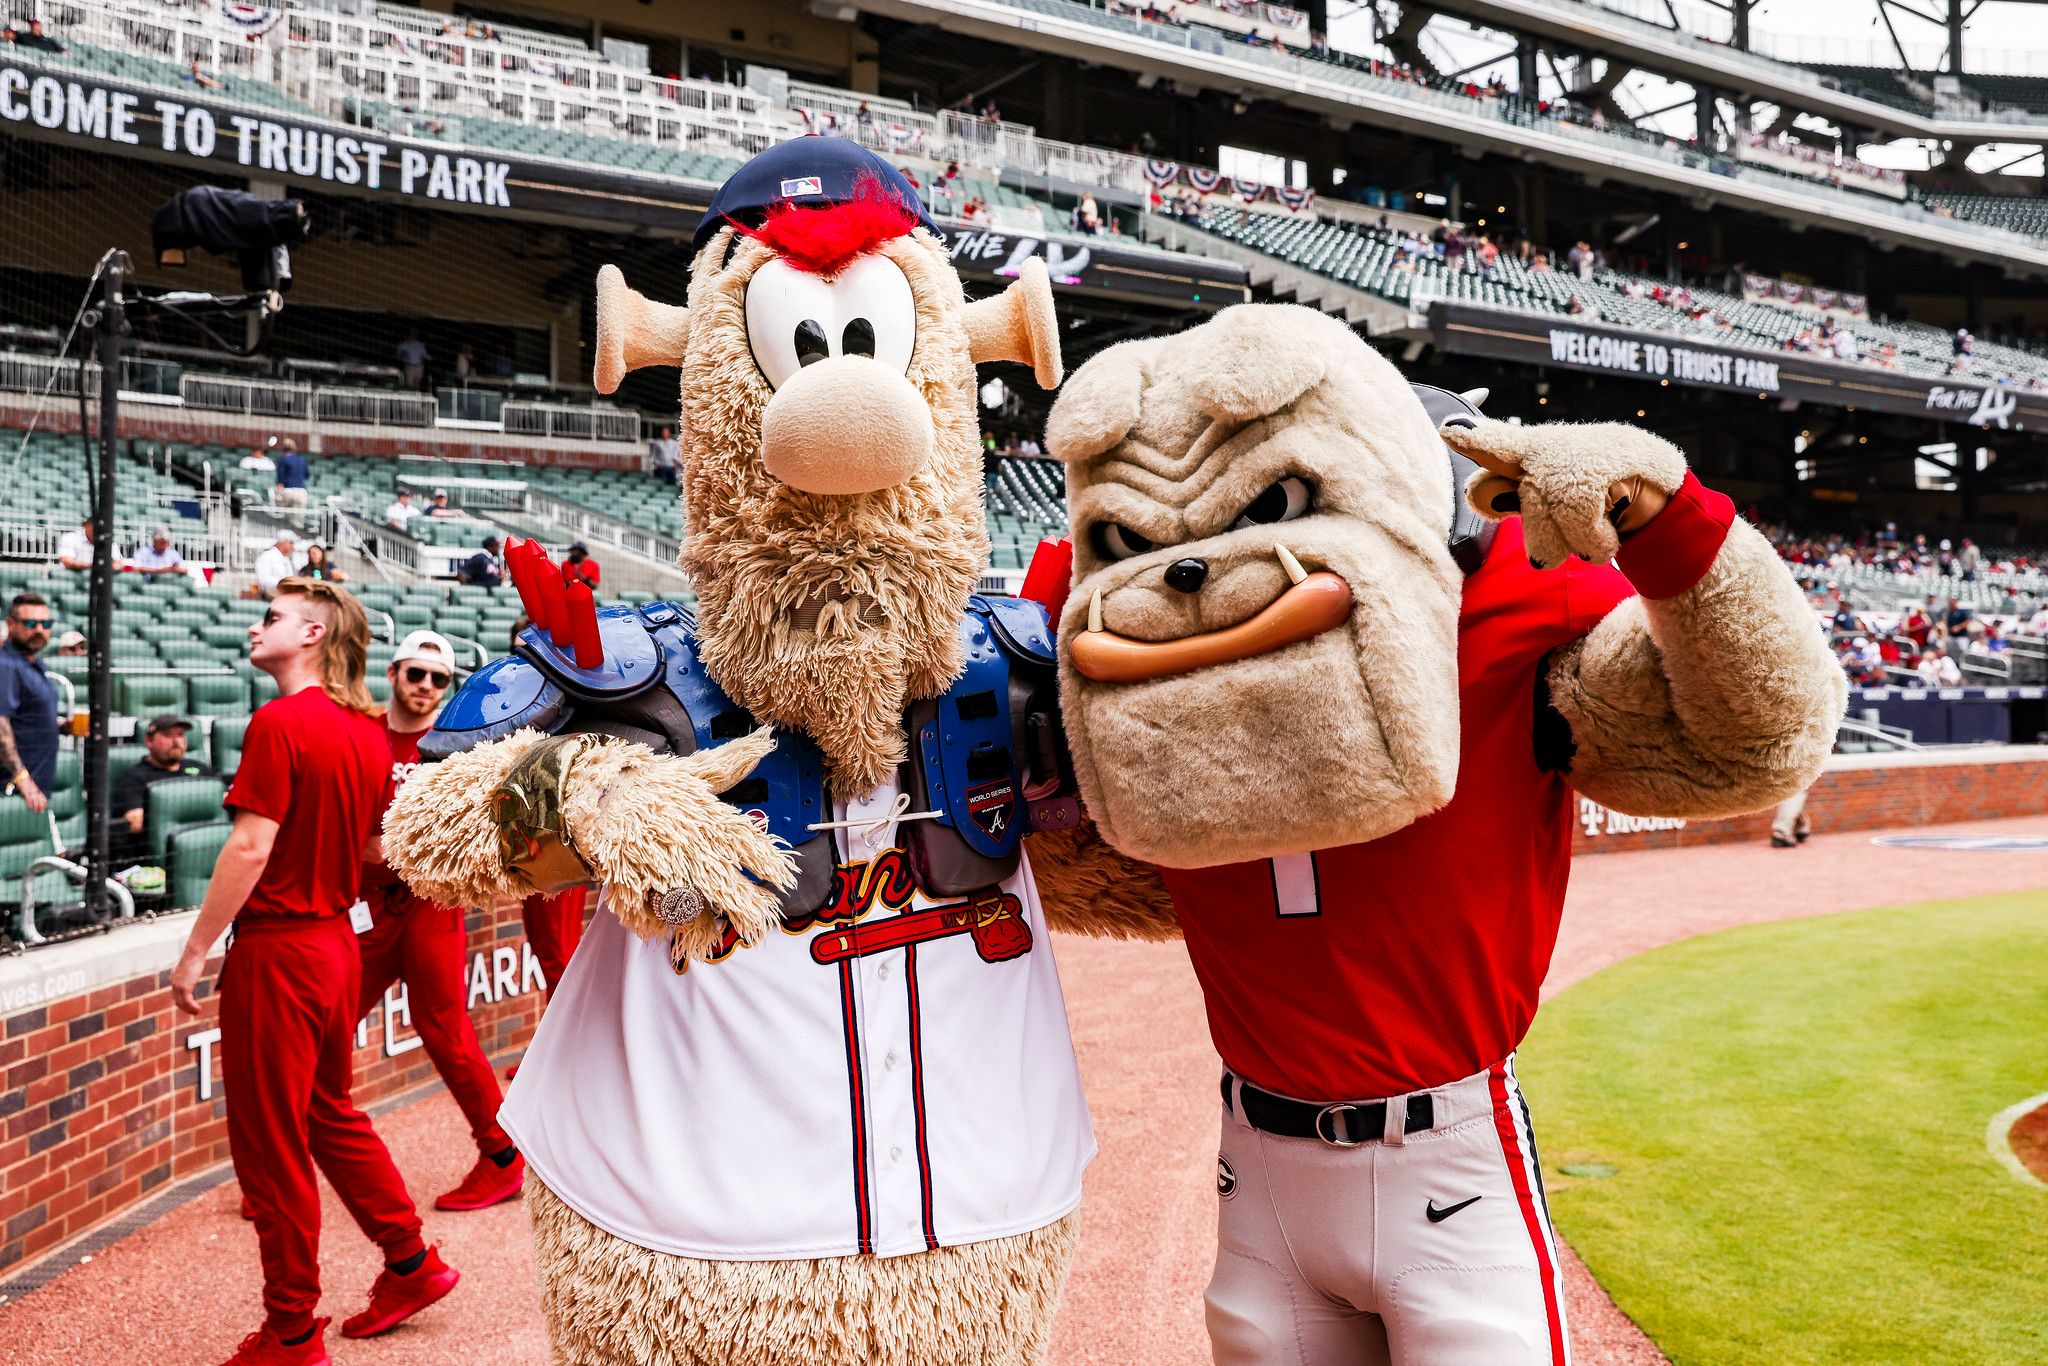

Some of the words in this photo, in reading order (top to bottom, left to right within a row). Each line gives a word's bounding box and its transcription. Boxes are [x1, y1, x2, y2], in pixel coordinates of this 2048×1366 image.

[0, 68, 139, 145] COME
[154, 100, 216, 158] TO
[230, 115, 388, 190] TRUIST
[401, 148, 511, 208] PARK
[950, 231, 1006, 261] THE
[1550, 329, 1642, 372] WELCOME
[1643, 343, 1669, 375] TO
[1671, 348, 1733, 385] TRUIST
[1735, 357, 1780, 391] PARK
[969, 792, 990, 803] WORLD
[991, 786, 1011, 797] SERIES
[465, 942, 547, 1009] ARK
